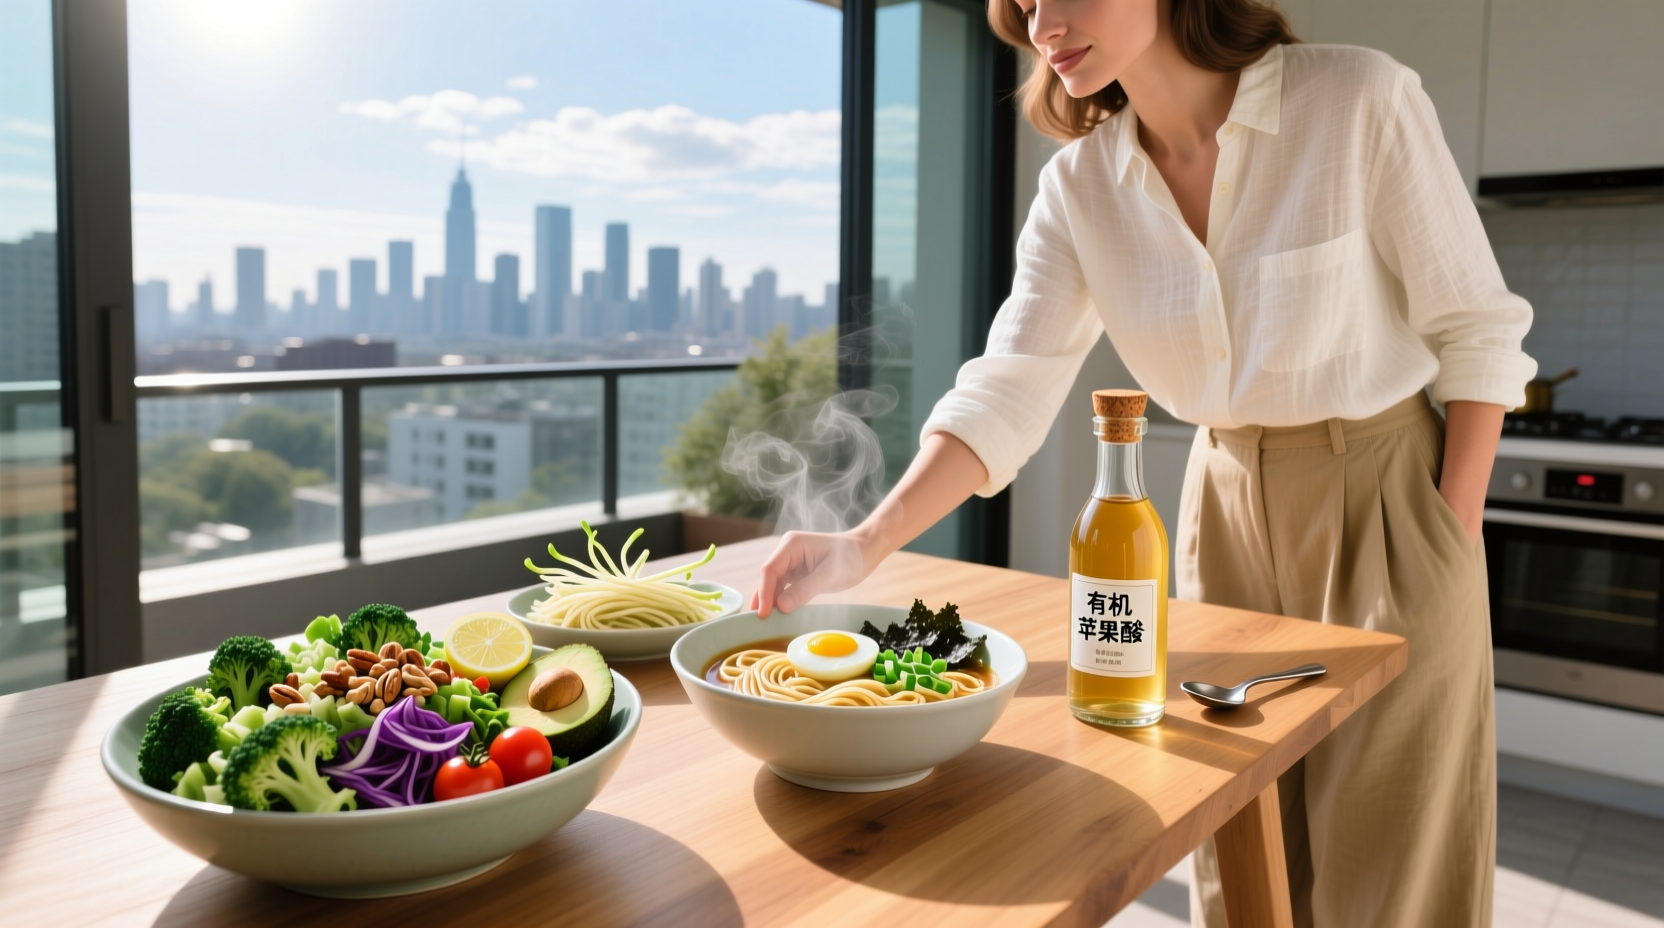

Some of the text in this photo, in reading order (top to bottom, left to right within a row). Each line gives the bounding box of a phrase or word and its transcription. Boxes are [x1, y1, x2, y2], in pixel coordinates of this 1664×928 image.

[1087, 590, 1133, 617] 有机
[1078, 616, 1145, 644] 苹果酸
